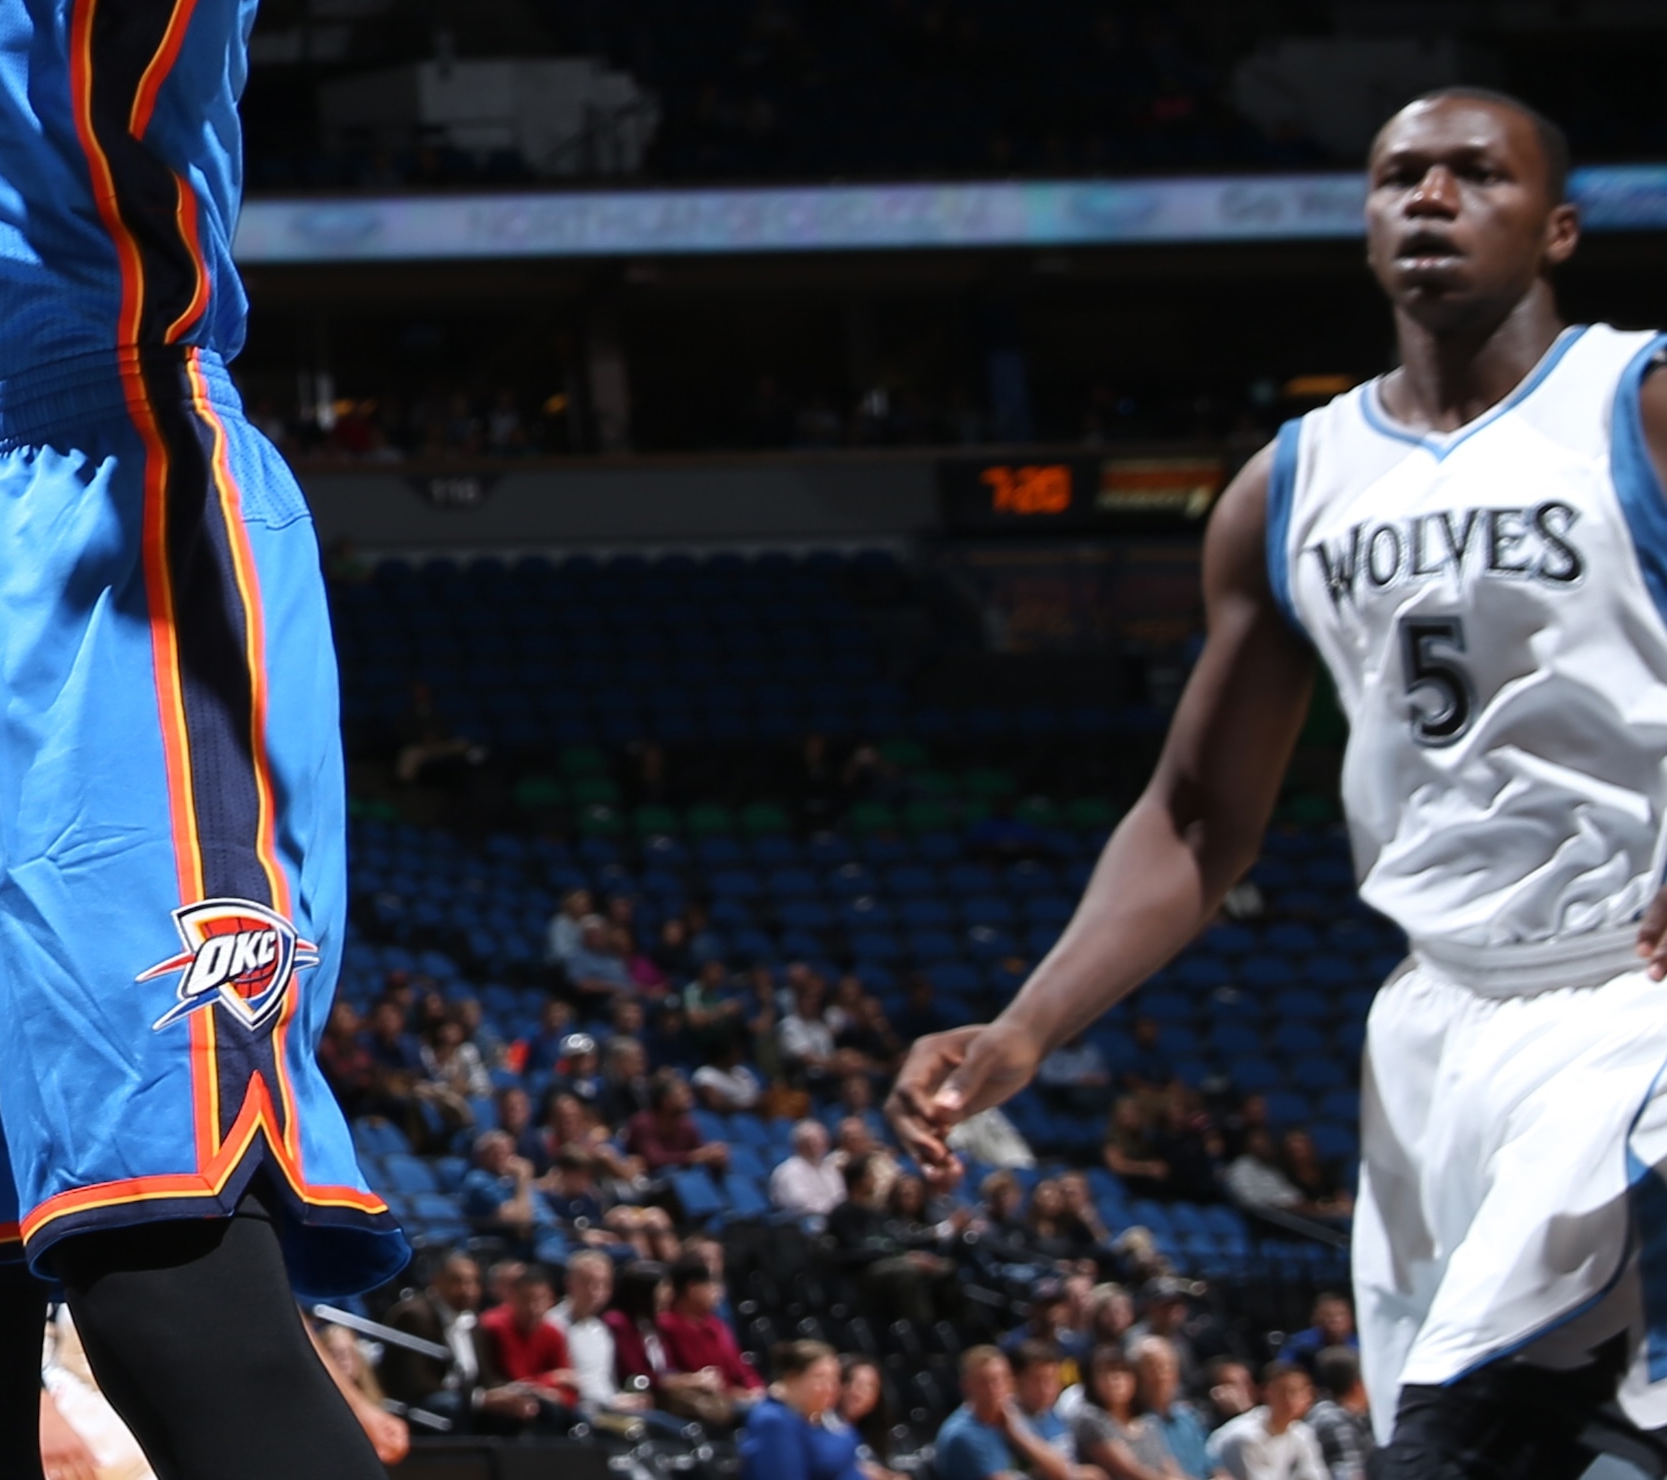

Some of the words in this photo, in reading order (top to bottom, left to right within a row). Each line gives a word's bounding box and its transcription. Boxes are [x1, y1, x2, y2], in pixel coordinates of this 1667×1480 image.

[1315, 500, 1585, 600] WOLVES
[1399, 615, 1477, 749] 5
[185, 928, 278, 998] OKC
